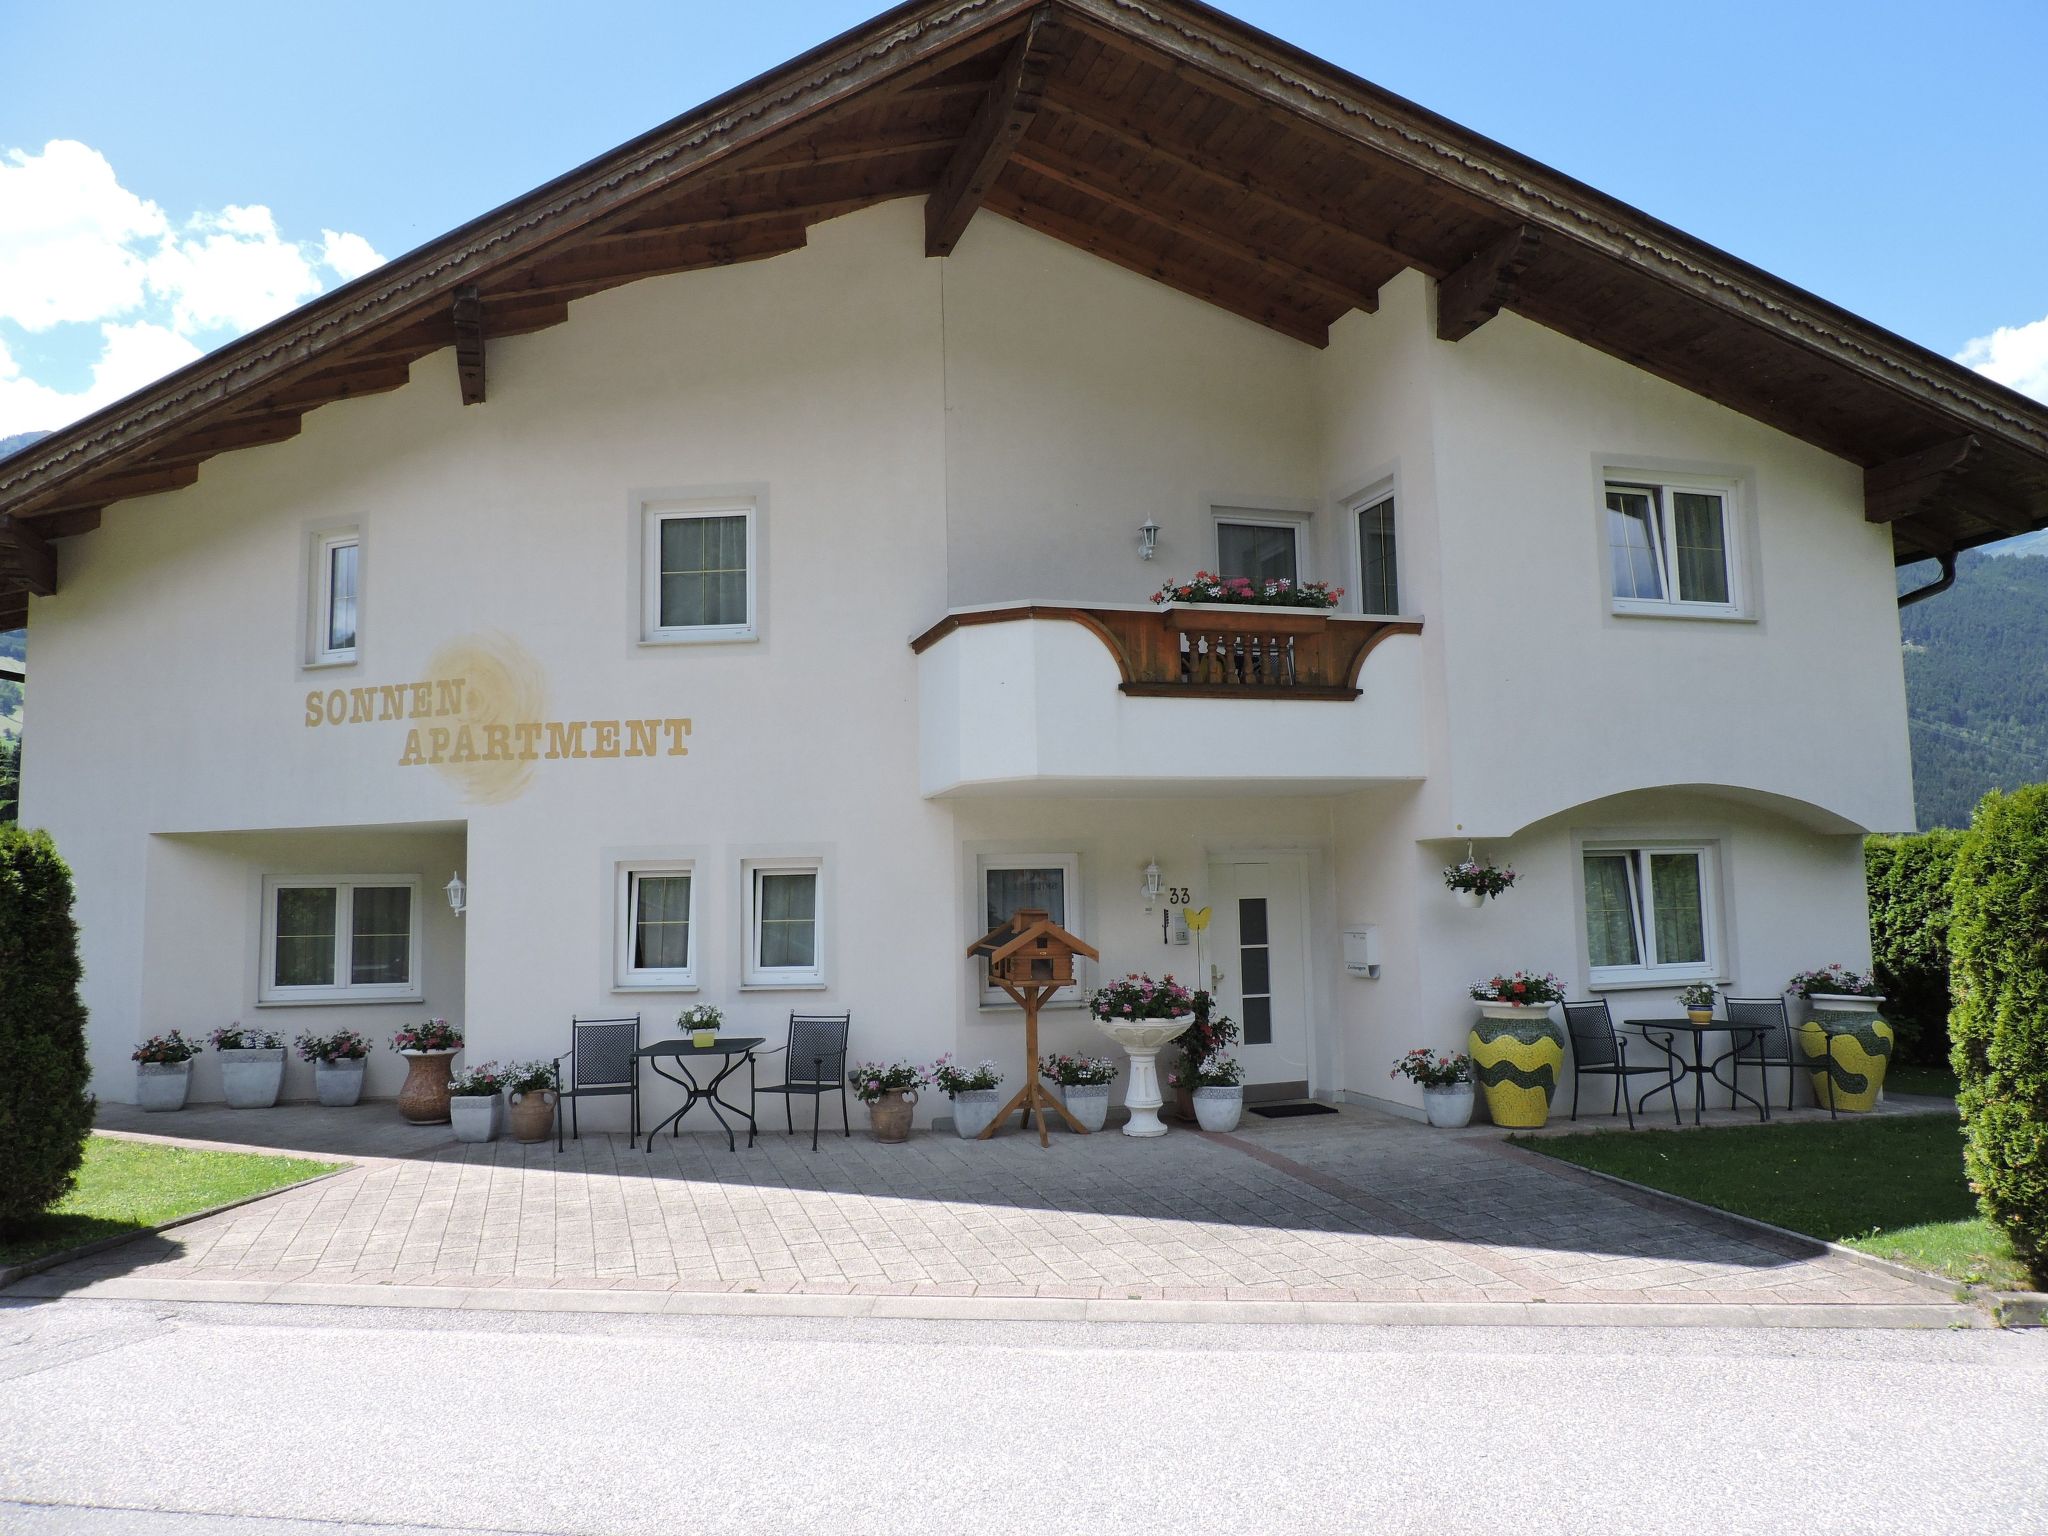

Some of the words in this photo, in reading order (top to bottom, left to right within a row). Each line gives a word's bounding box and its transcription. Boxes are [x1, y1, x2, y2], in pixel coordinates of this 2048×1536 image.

[305, 678, 466, 727] SONNEN
[399, 718, 692, 766] APARTMENT
[1169, 887, 1191, 905] 33
